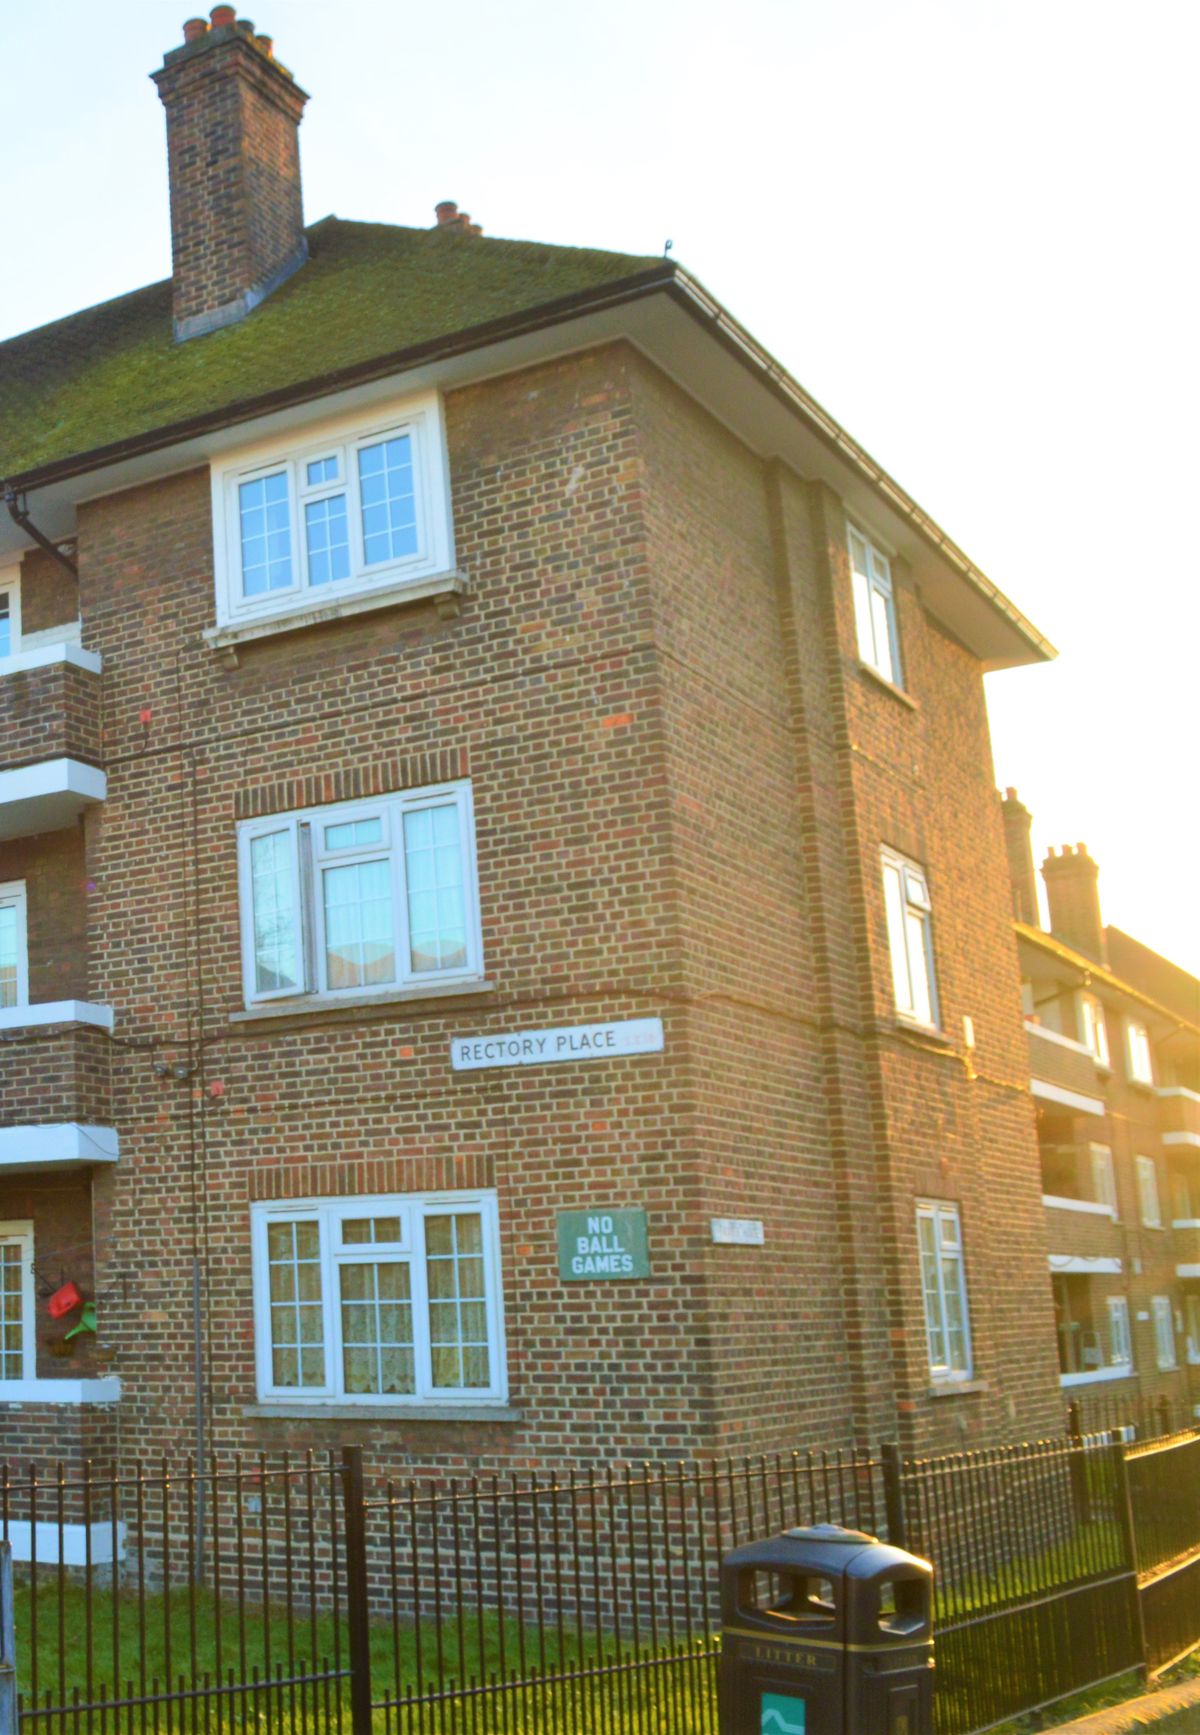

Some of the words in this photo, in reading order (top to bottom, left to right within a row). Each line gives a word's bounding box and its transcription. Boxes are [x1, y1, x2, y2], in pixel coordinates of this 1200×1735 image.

[460, 1037, 547, 1062] RECTORY
[556, 1030, 617, 1052] PLACE
[587, 1216, 613, 1234] NO
[576, 1234, 626, 1254] BALL
[571, 1254, 634, 1274] GAMES
[755, 1647, 818, 1666] LITTER
